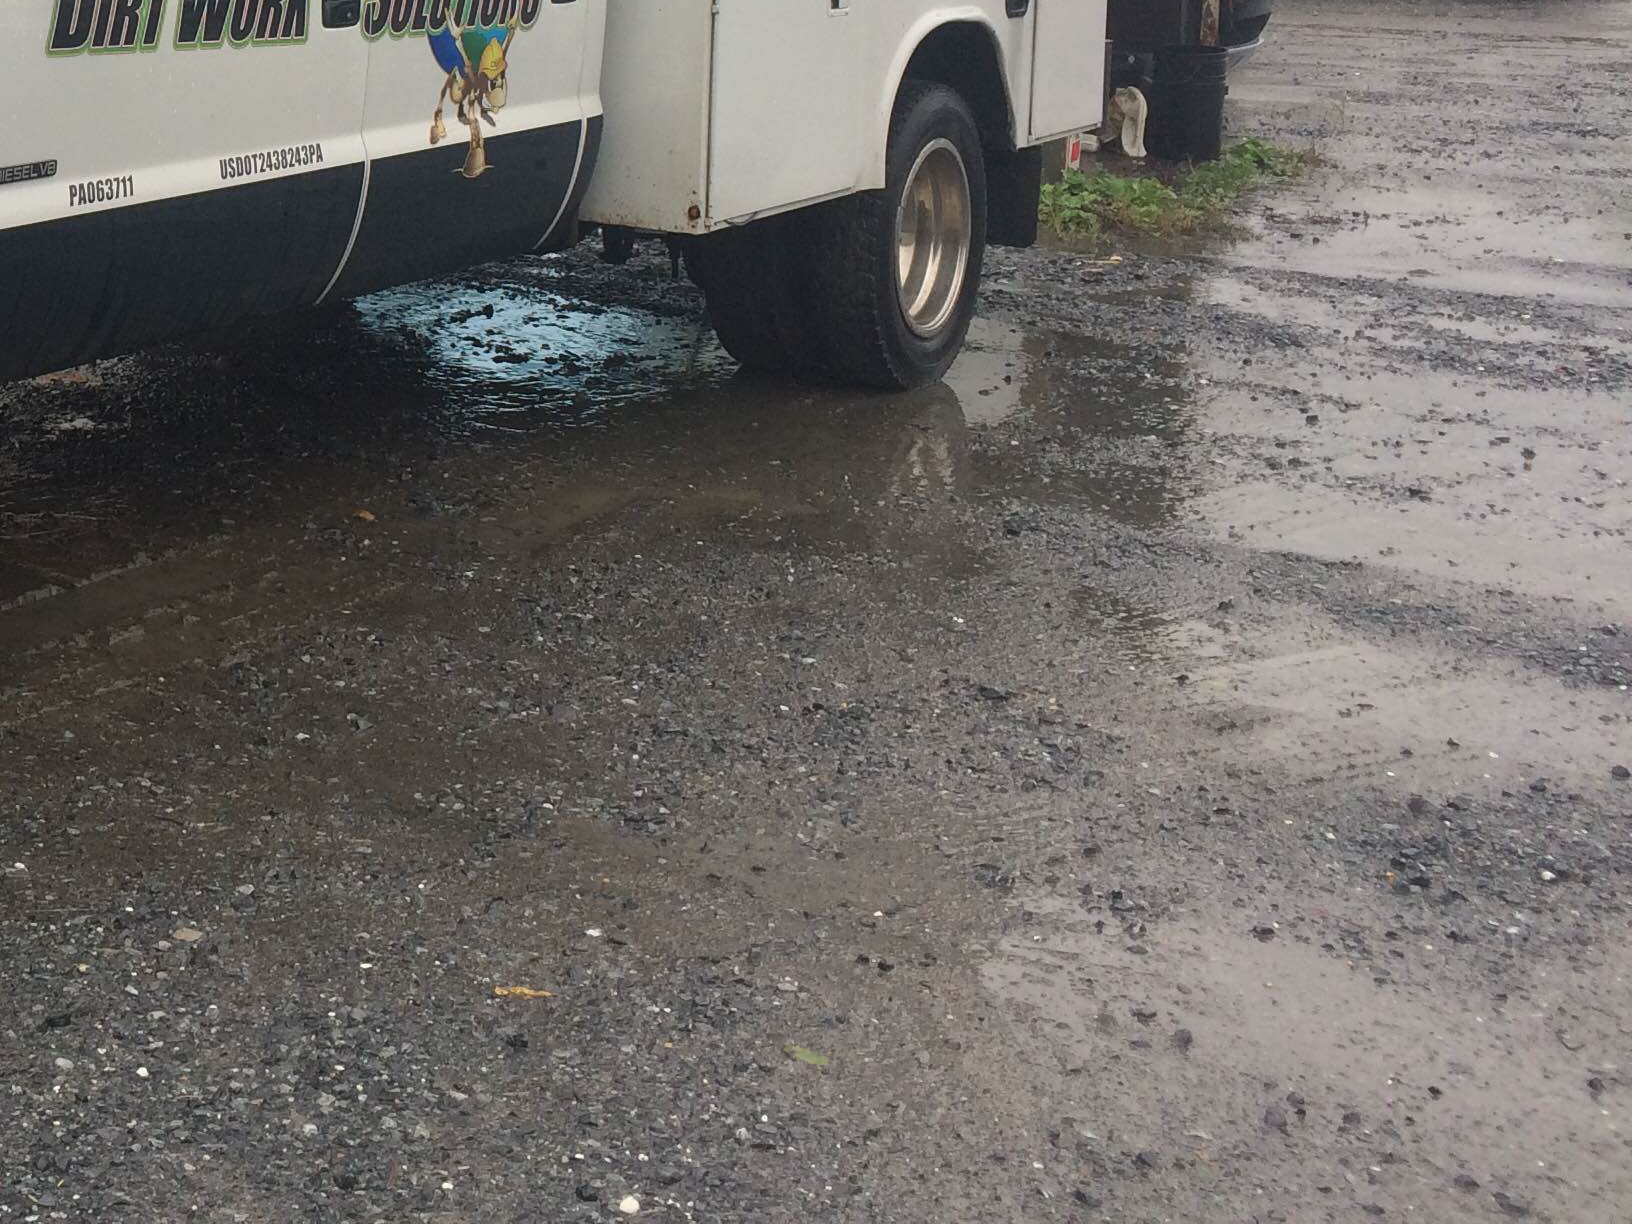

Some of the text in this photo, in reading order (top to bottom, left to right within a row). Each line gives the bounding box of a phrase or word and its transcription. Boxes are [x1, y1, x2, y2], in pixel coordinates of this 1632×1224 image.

[39, 161, 56, 176] V8
[219, 142, 324, 180] USDOT2438243PA
[69, 174, 134, 207] PA063711
